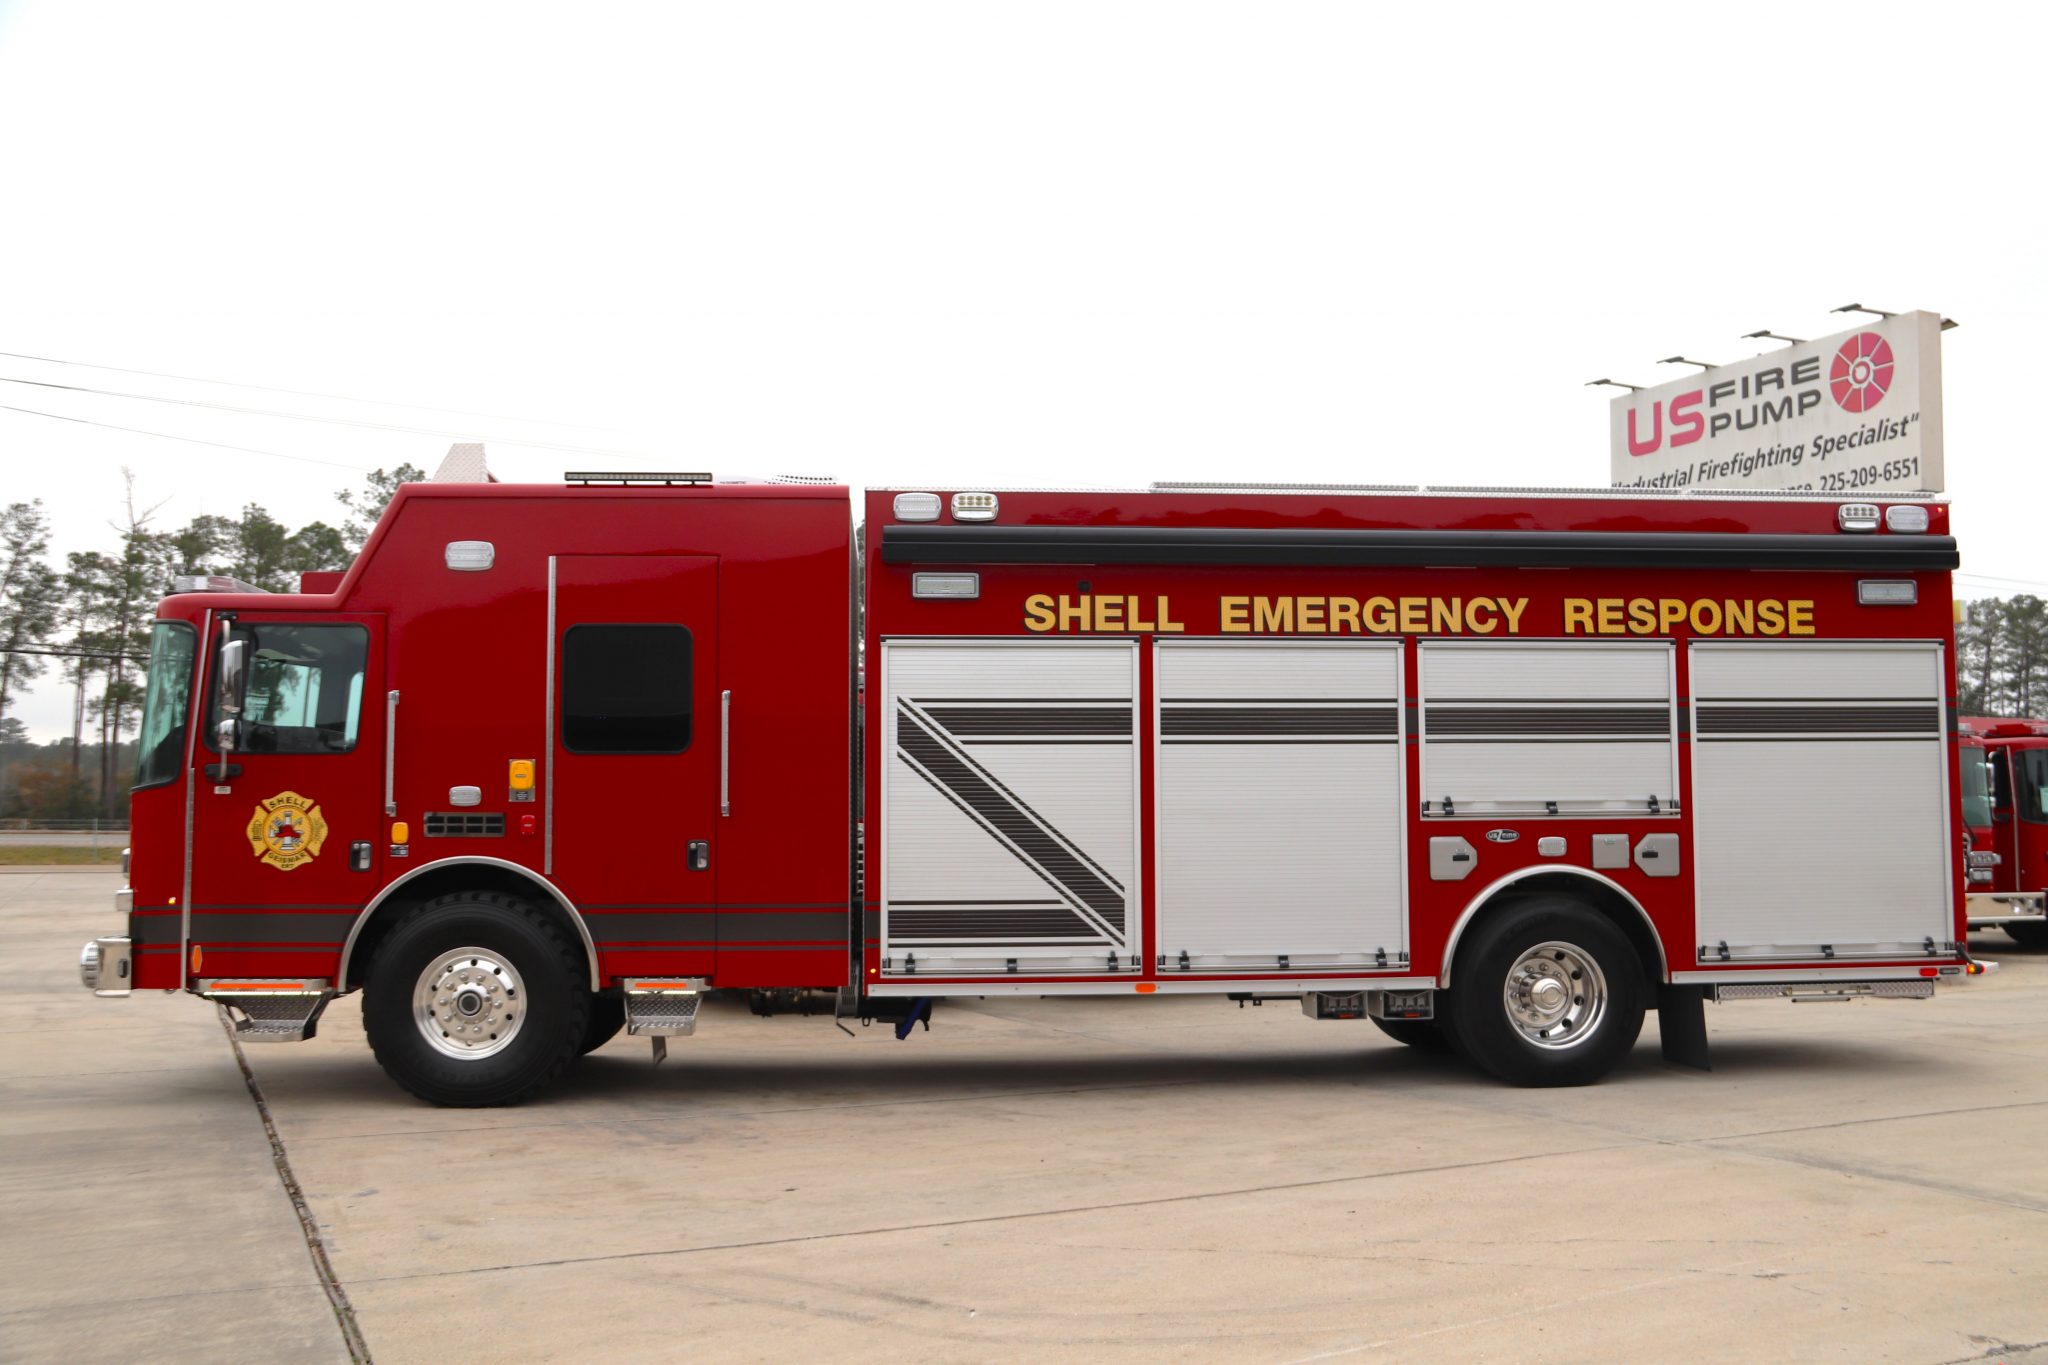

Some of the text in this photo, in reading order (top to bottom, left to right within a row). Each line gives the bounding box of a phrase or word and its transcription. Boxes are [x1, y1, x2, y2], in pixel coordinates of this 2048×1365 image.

[1627, 355, 1820, 457] US FIRE
[1709, 389, 1822, 438] PUMP
[1697, 443, 1805, 482] Firefighting
[1820, 456, 1919, 490] 225-209-6551
[1024, 593, 1816, 635] SHELL EMERGENCY RESPONSE
[269, 796, 305, 808] SHELL
